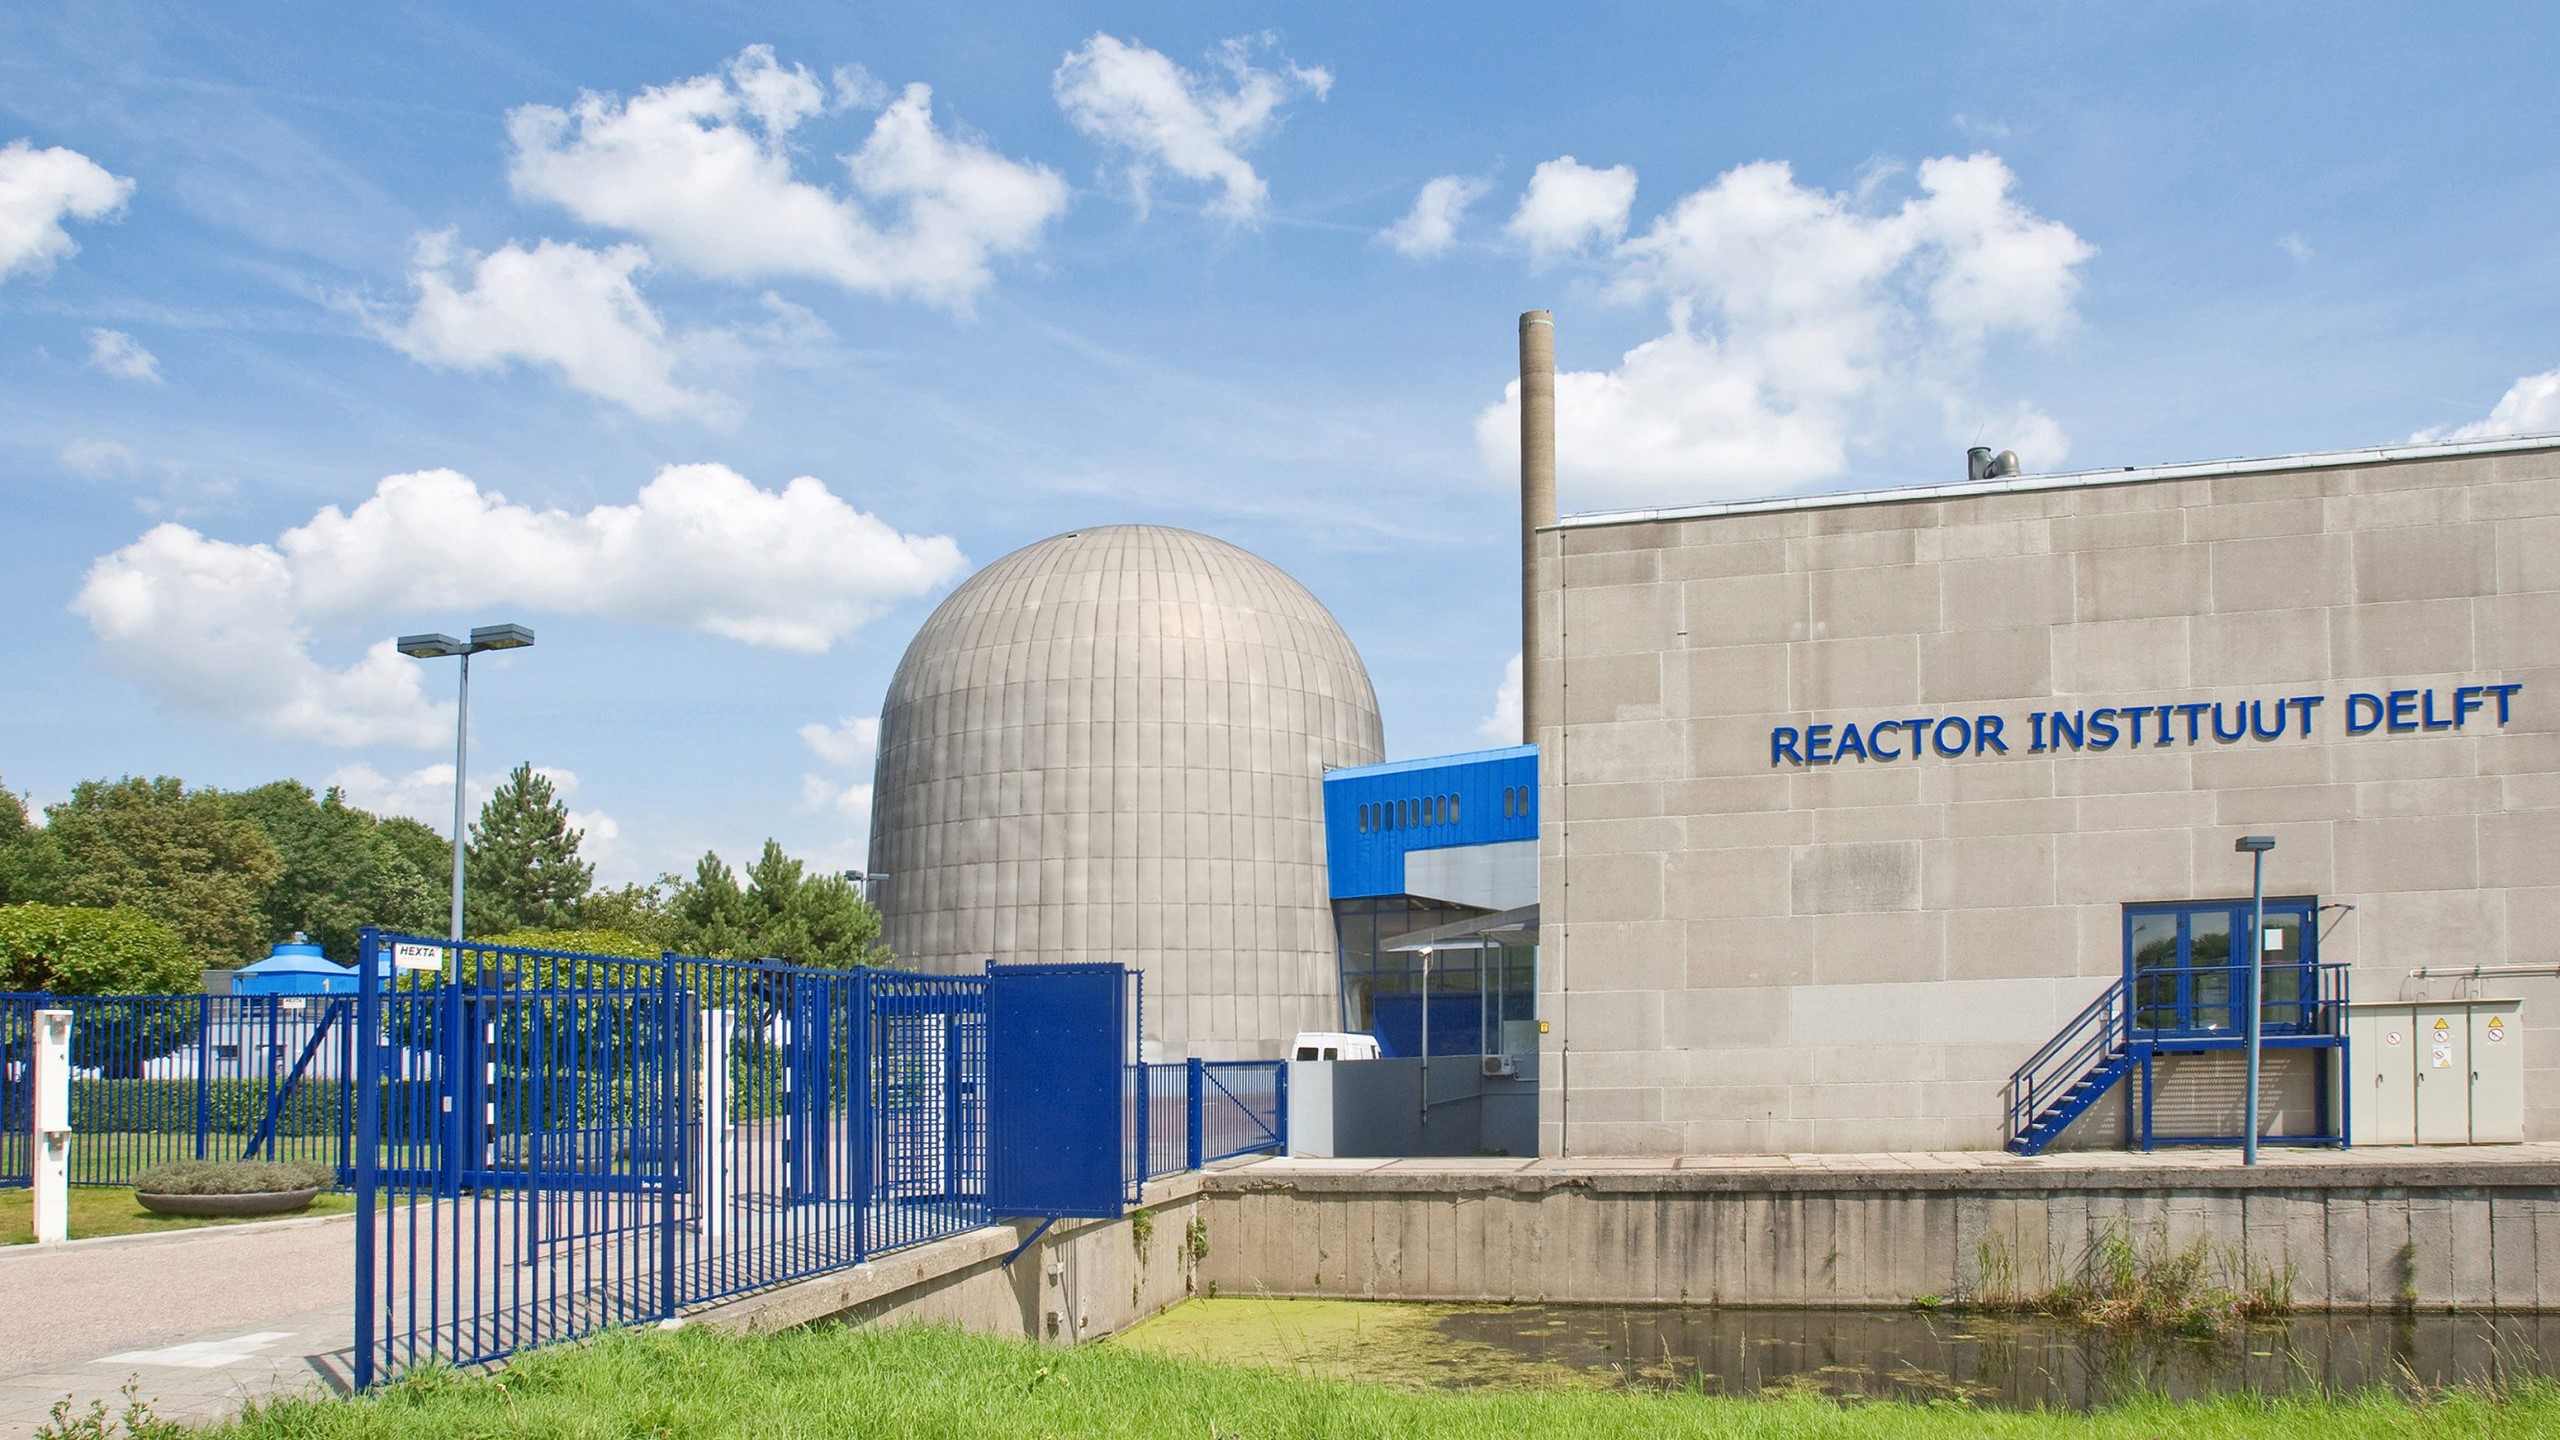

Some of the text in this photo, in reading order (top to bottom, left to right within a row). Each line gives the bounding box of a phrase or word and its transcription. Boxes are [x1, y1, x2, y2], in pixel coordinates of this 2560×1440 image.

[1772, 683, 2523, 765] REACTOR INSTITUUT DELFT
[399, 946, 435, 957] HEXTA
